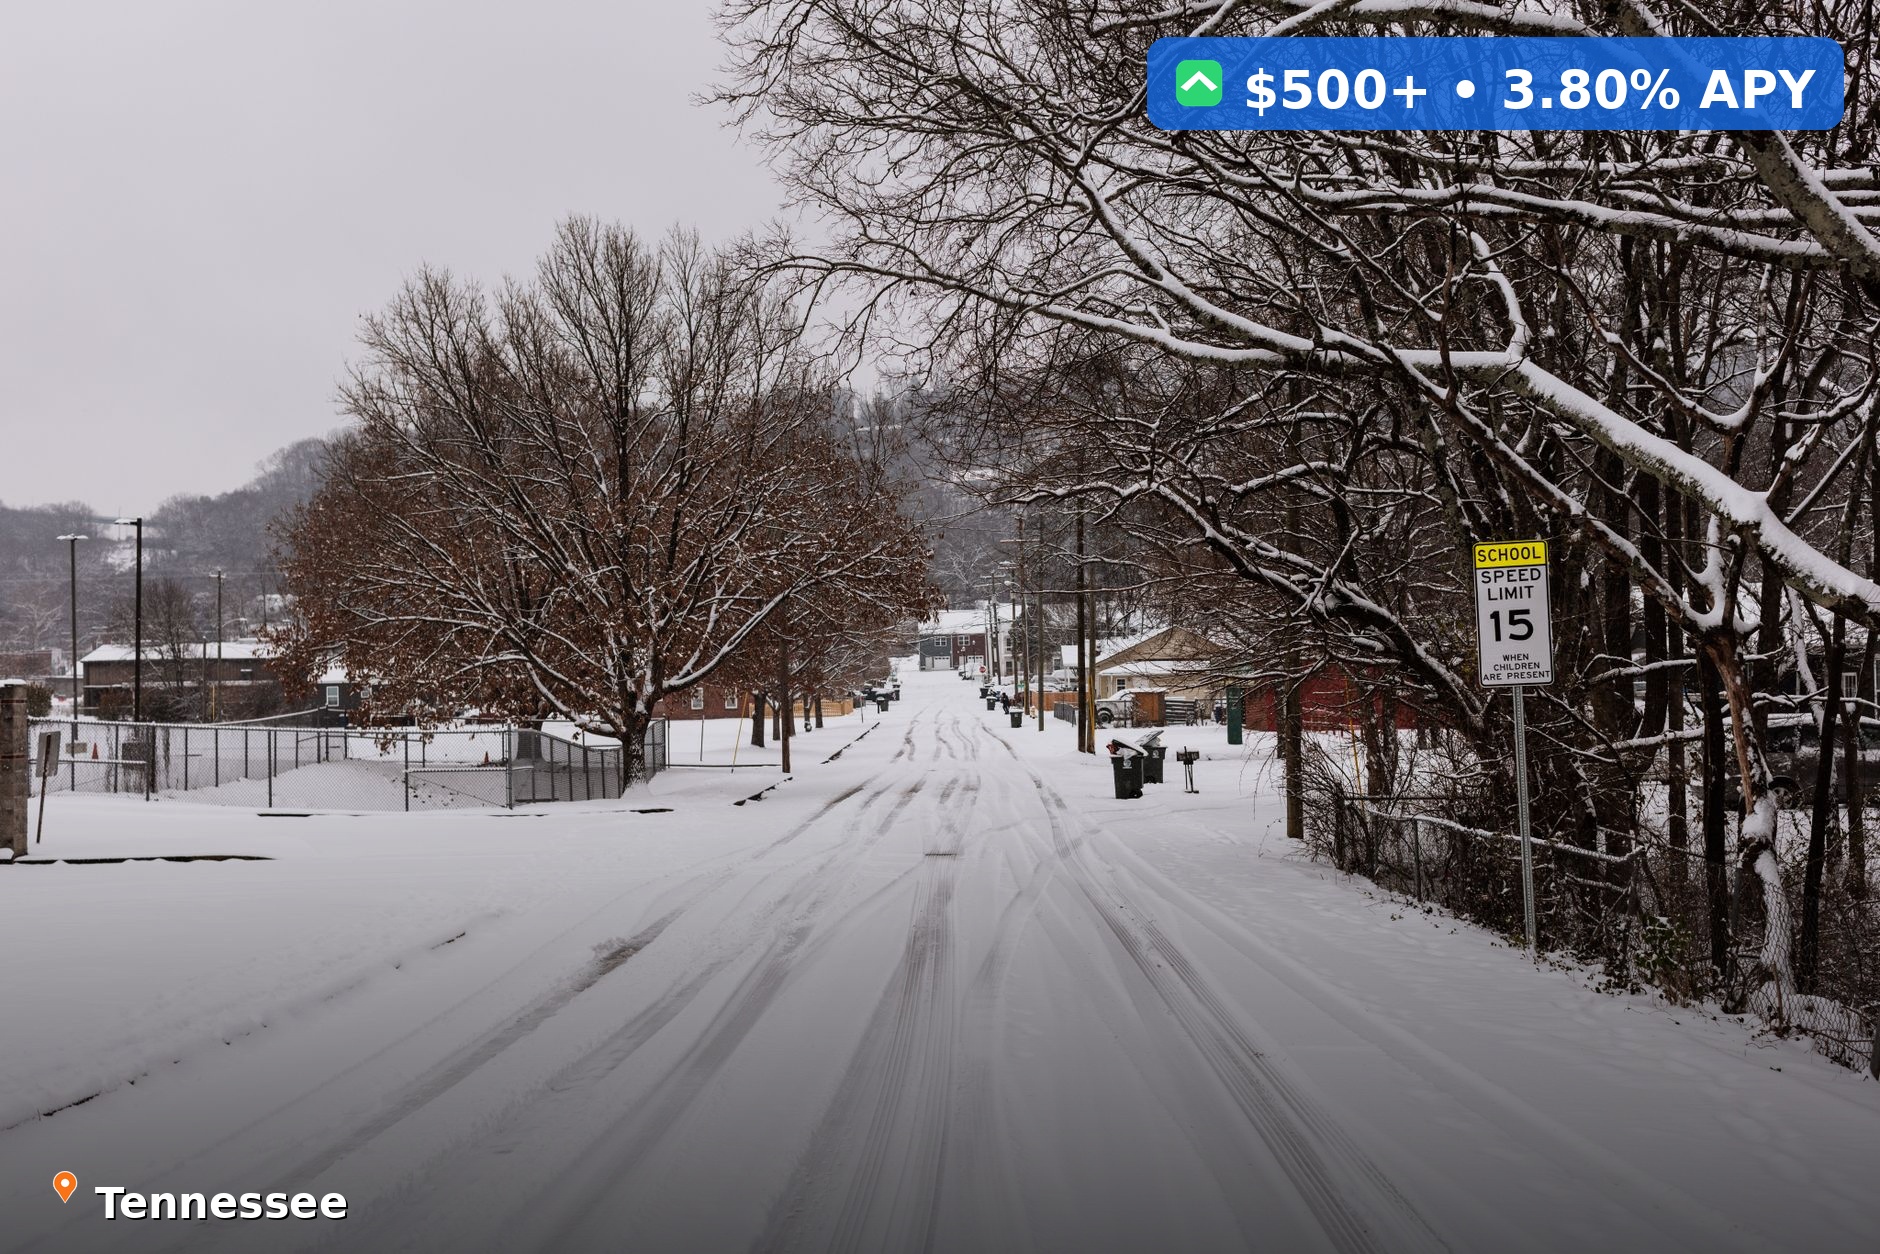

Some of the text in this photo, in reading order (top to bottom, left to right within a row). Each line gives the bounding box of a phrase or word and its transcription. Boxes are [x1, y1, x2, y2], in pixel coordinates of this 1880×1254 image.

[1477, 546, 1542, 563] SCHOOL
[1481, 568, 1541, 584] SPEED
[1487, 585, 1534, 601] LIMIT
[1489, 609, 1534, 642] 15
[1502, 653, 1529, 662] WHEN
[1493, 662, 1540, 672] CHILDREN
[1483, 670, 1551, 681] ARE PRESENT
